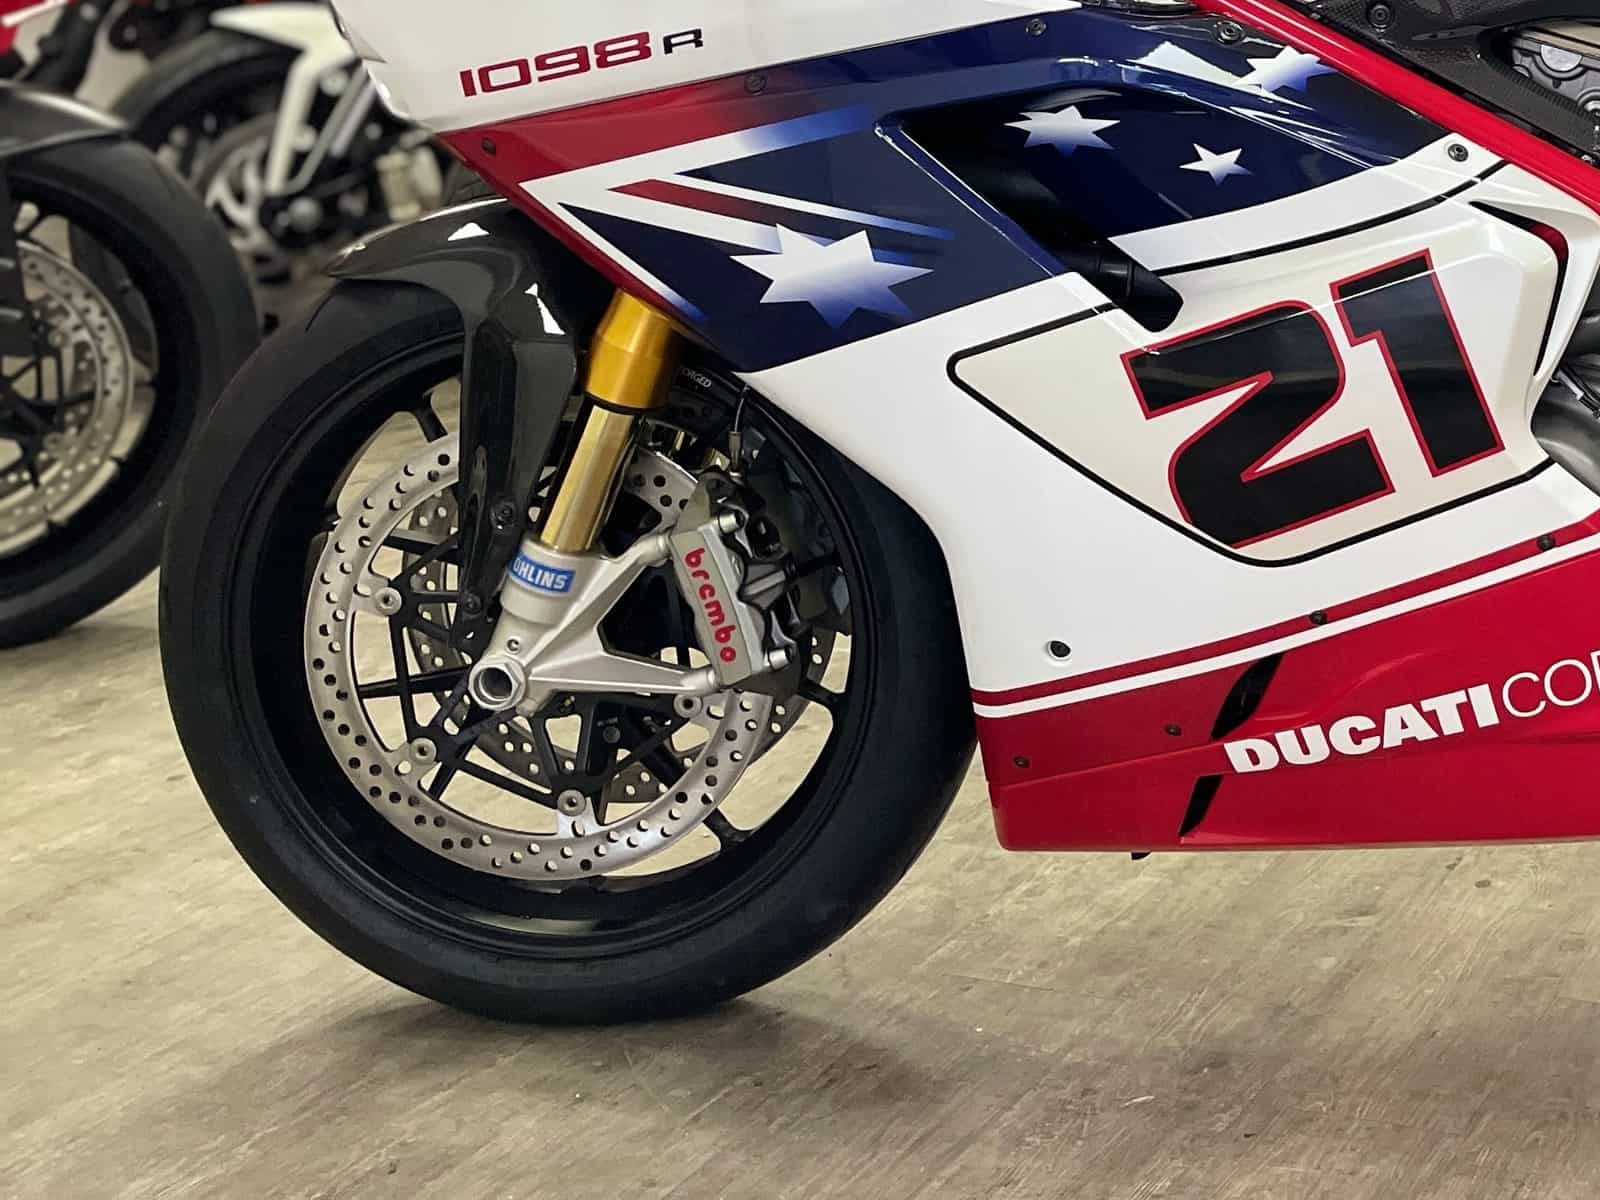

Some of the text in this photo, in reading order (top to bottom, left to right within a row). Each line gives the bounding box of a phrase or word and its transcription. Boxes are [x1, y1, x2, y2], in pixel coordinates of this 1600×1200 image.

[459, 28, 703, 98] 1098 R
[1119, 247, 1506, 550] 21
[684, 548, 737, 663] brembo
[1223, 683, 1500, 774] DUCATI
